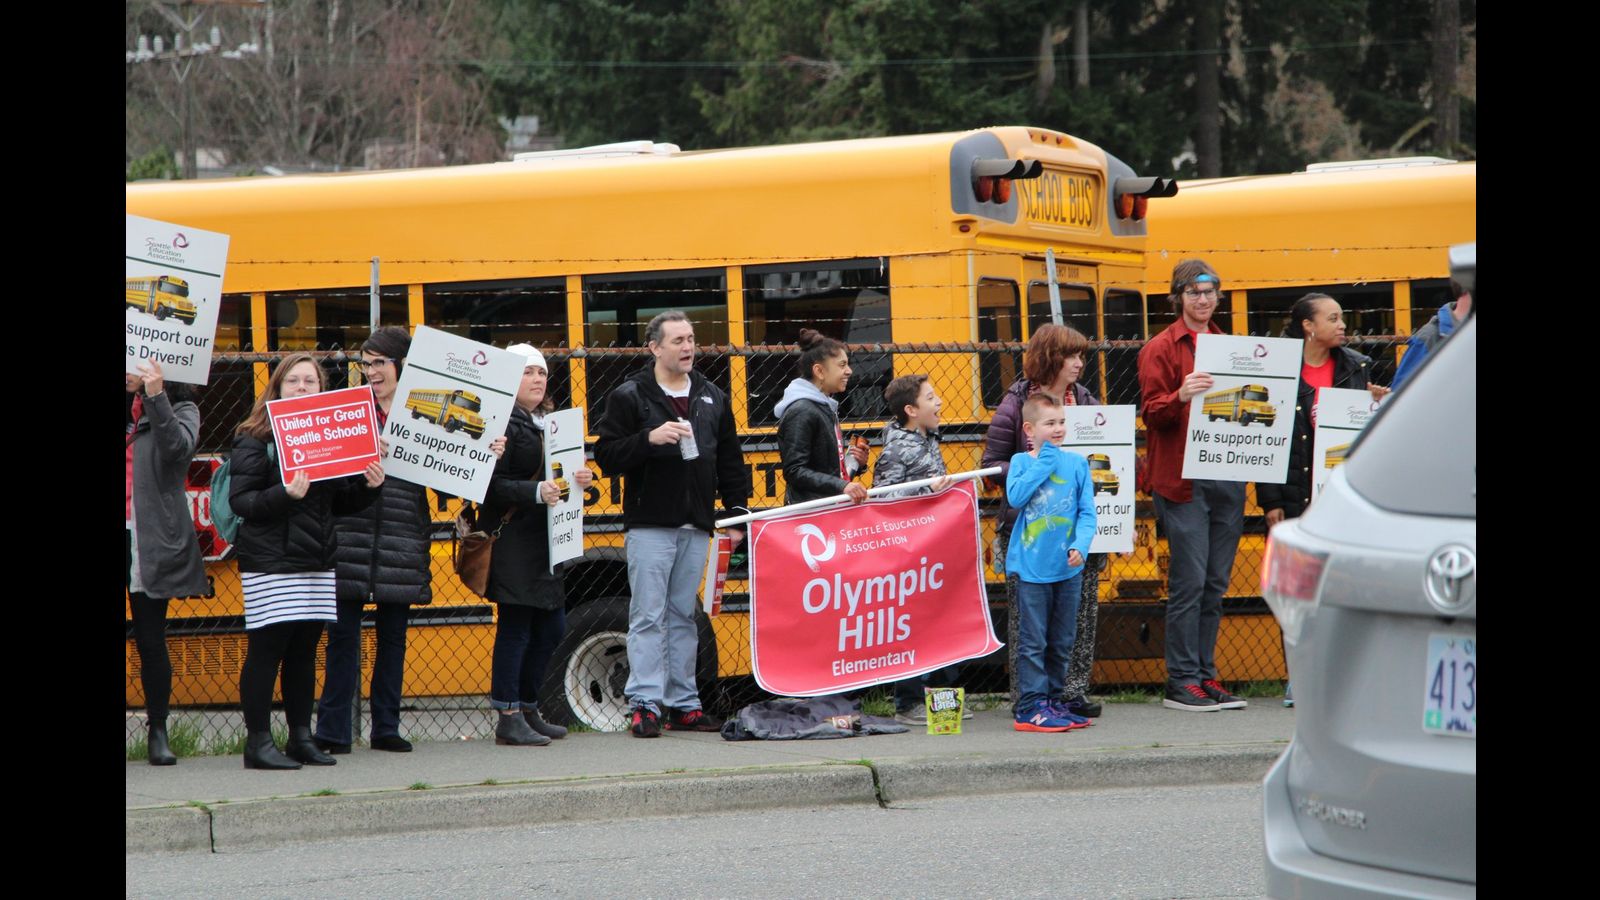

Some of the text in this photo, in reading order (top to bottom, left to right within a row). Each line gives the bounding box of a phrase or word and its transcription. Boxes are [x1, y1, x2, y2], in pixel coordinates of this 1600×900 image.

[1022, 171, 1093, 227] SCHOOL BUS
[126, 323, 209, 348] support our
[139, 345, 194, 366] Drivers!
[280, 406, 366, 431] United for Great
[285, 423, 368, 447] Seattle Schools
[389, 421, 493, 464] We support our
[1192, 429, 1287, 447] We support our
[392, 445, 476, 481] Bus Drivers!
[1198, 449, 1274, 466] Bus Drivers!
[566, 508, 581, 521] our
[1095, 503, 1131, 515] ort our
[839, 515, 936, 540] SEATTLE EDUCATION
[845, 535, 908, 554] ASSOCIATION
[802, 556, 944, 617] Olympic
[838, 606, 911, 652] Hills
[831, 649, 916, 677] Elementary
